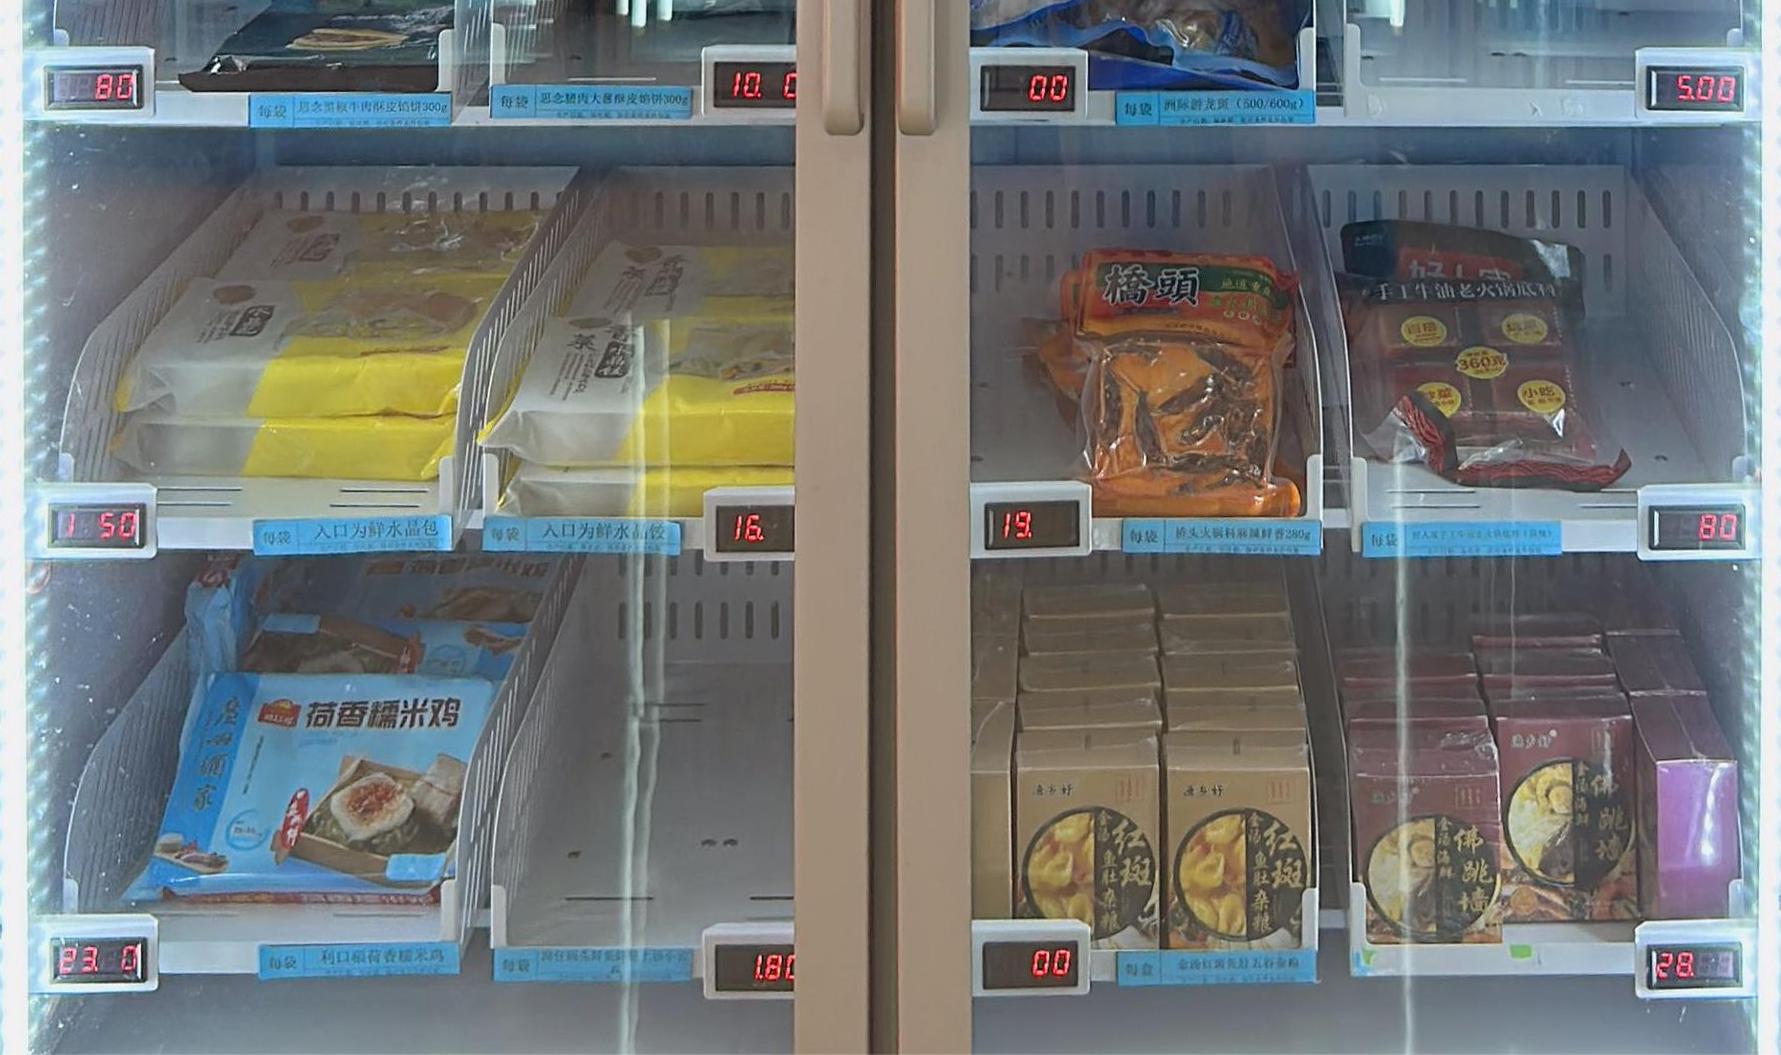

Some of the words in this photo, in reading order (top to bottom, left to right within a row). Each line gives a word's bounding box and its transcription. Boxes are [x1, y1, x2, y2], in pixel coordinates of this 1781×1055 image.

[1102, 264, 1199, 306] 橋頭
[305, 697, 463, 730] 荷香糯米鸡
